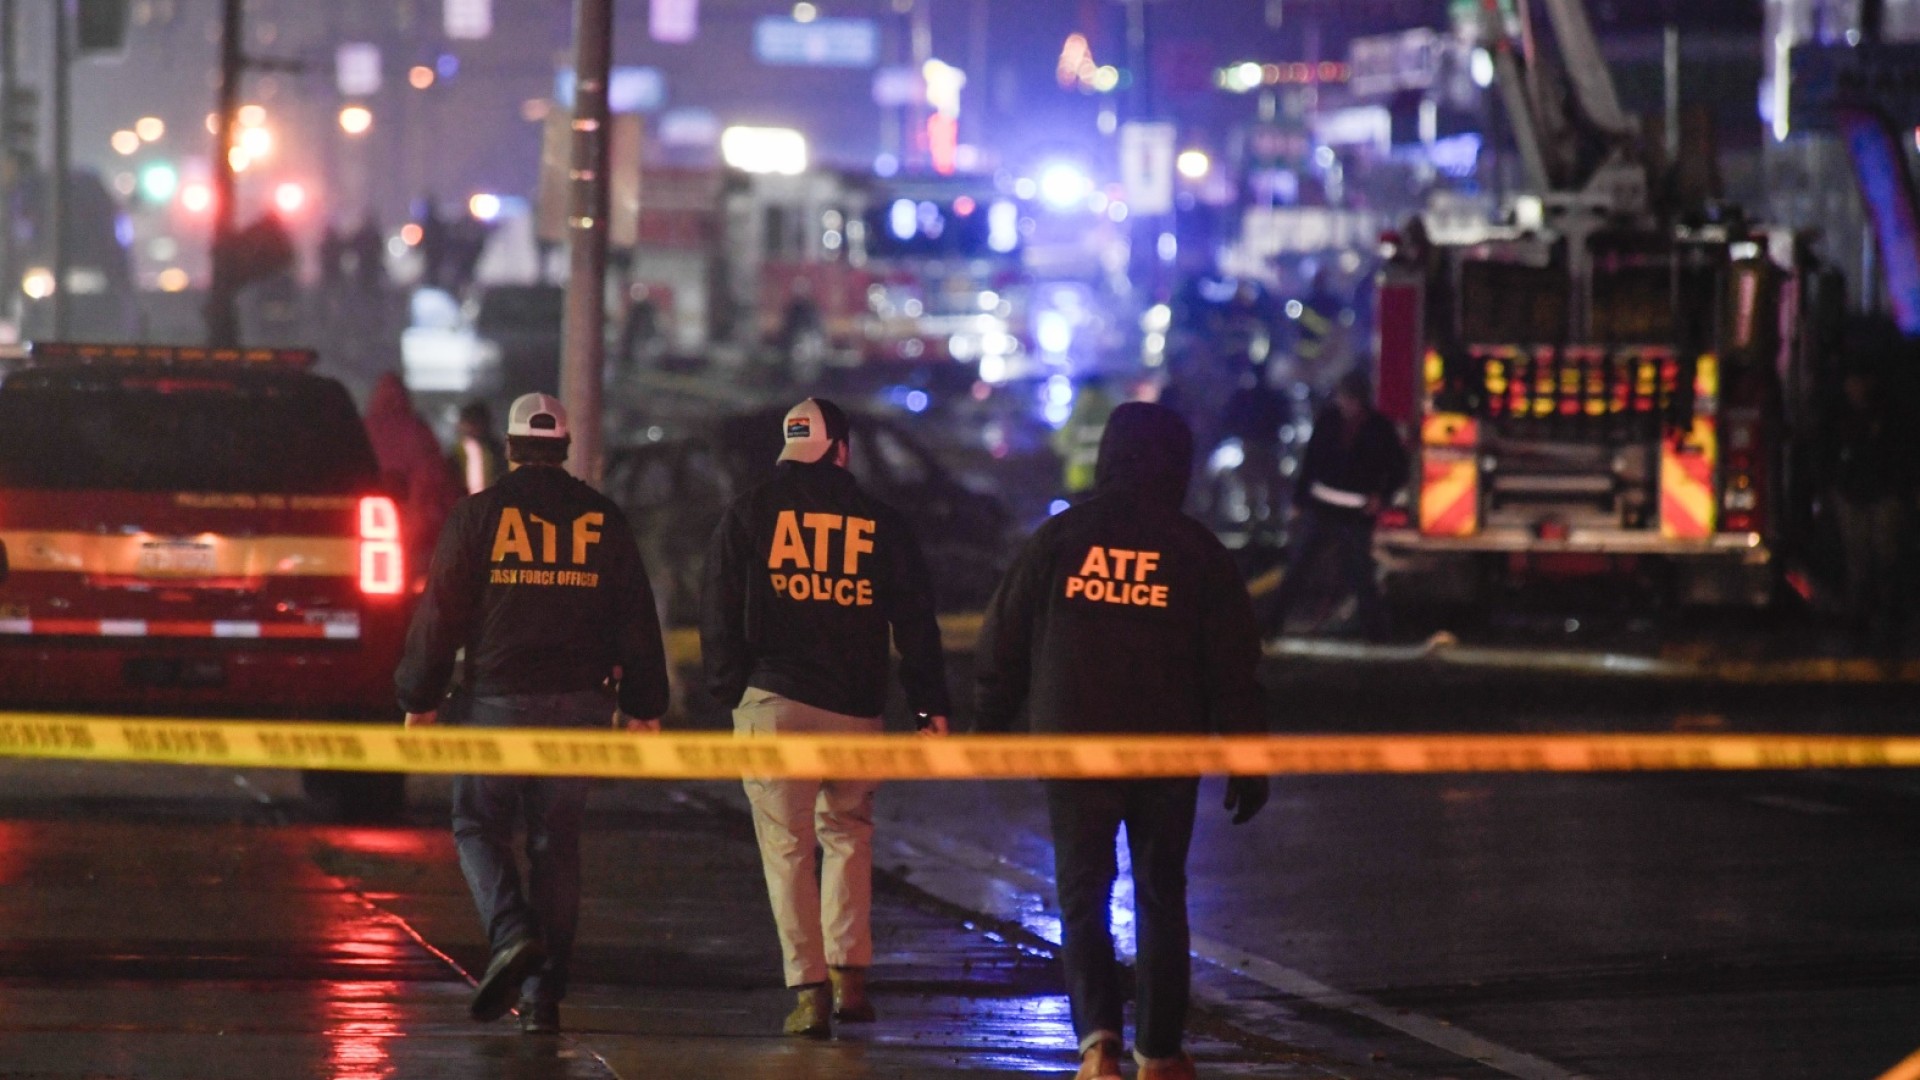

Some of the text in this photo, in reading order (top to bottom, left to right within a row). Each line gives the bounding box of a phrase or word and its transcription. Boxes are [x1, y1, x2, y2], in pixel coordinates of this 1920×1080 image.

[491, 506, 604, 565] ATF
[768, 510, 876, 575] ATF
[520, 569, 555, 585] FORCE
[557, 570, 599, 588] OFFICER
[1080, 545, 1161, 582] ATF
[770, 573, 873, 606] POLICE
[1065, 576, 1168, 607] POLICE
